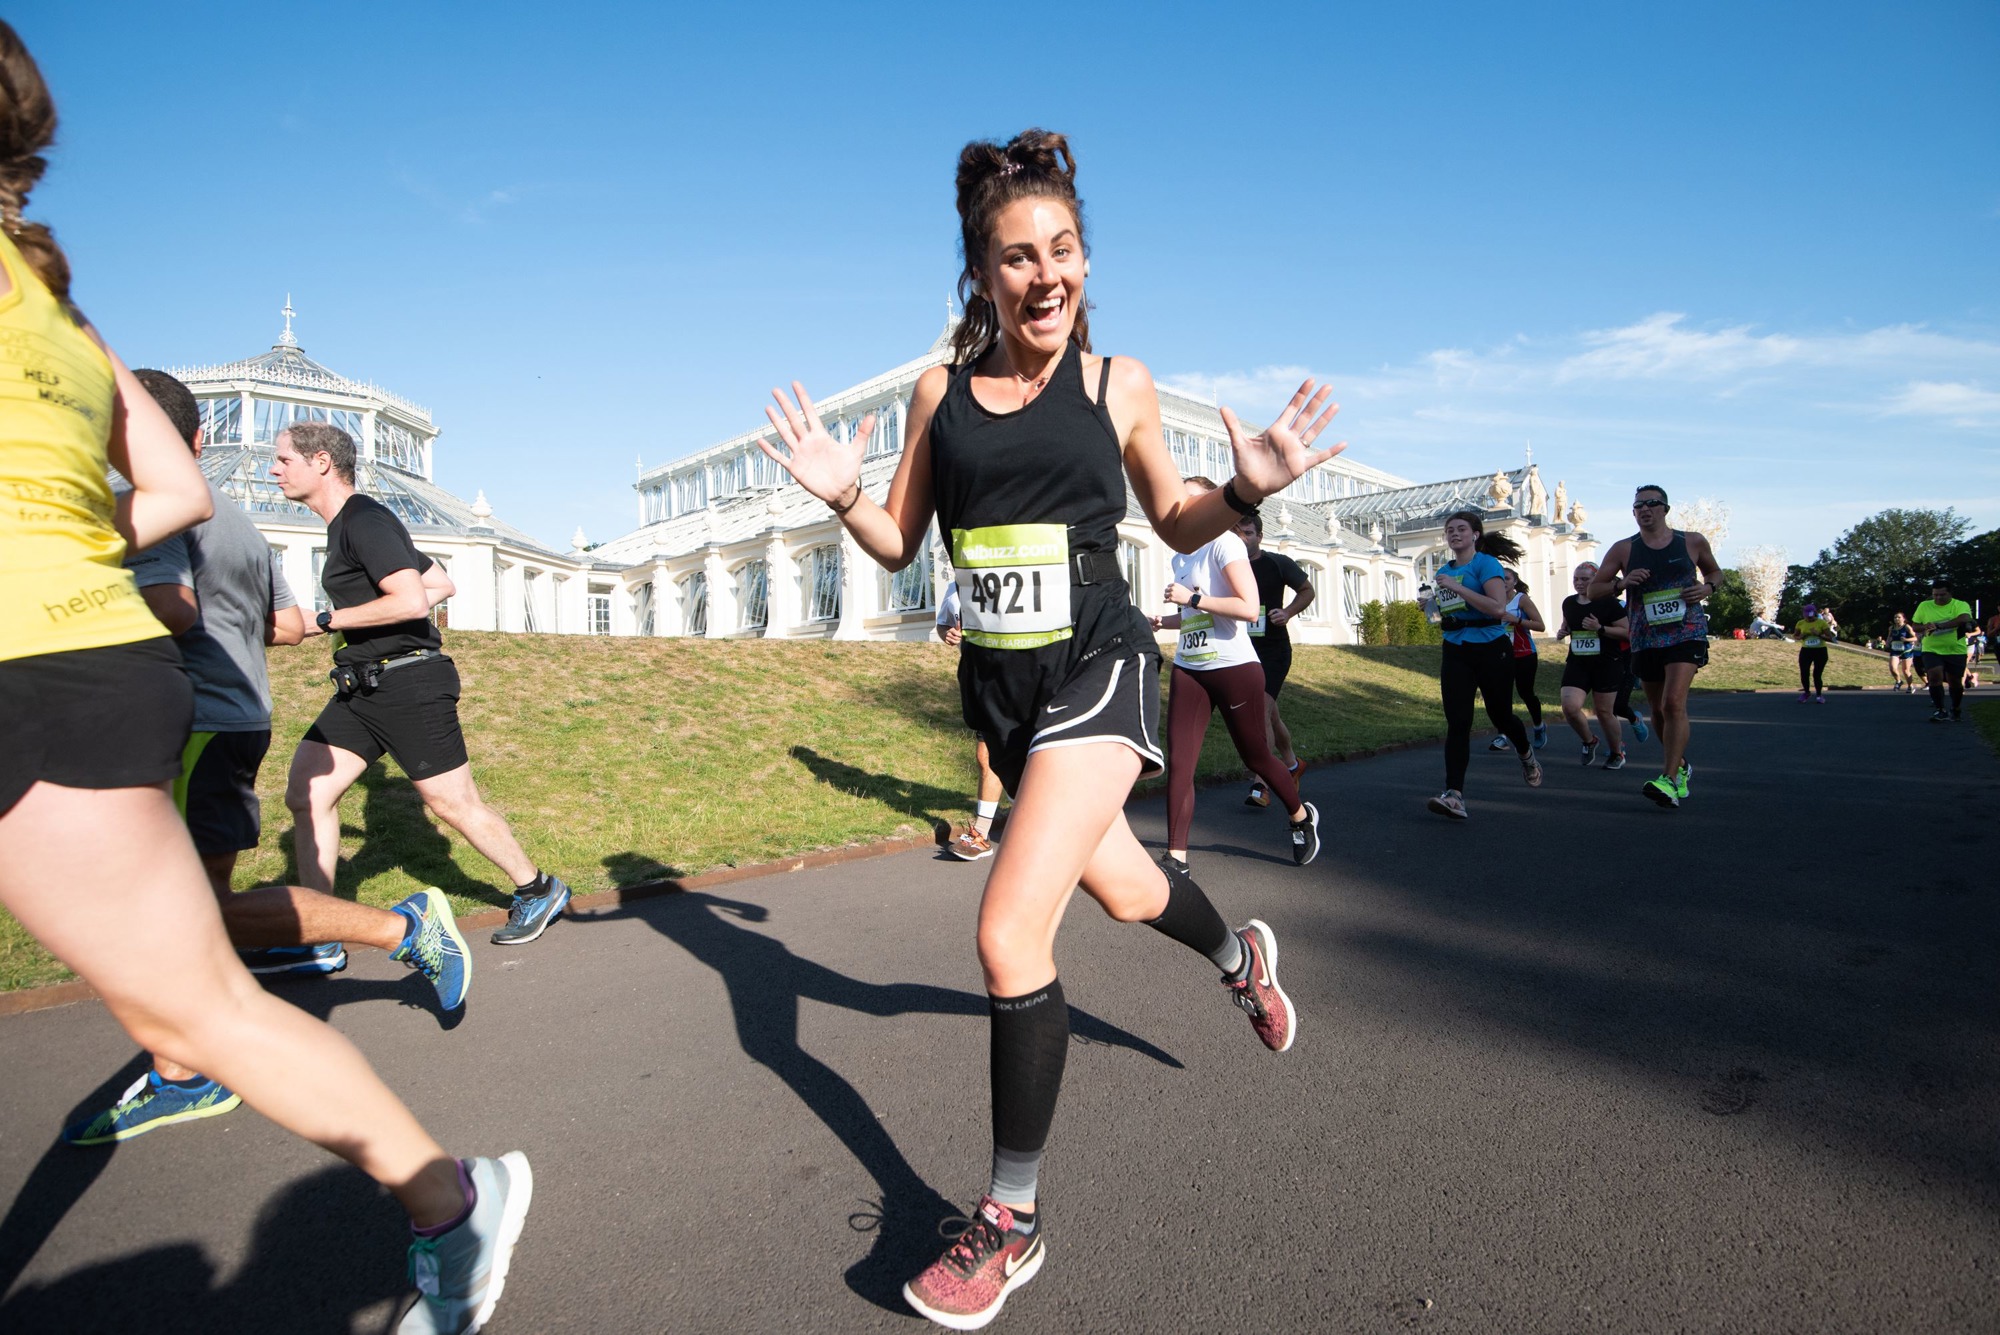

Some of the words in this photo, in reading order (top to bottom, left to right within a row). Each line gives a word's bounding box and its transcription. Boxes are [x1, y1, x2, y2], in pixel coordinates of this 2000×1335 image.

[24, 368, 60, 386] HELP
[962, 543, 1059, 561] albuzz.com
[971, 570, 1042, 614] 4921
[43, 583, 131, 622] helpm
[1652, 600, 1680, 616] 1389
[981, 637, 999, 647] KEW
[1001, 636, 1049, 648] GARDENS
[1576, 639, 1595, 649] 1765
[1015, 992, 1049, 1010] GEAR
